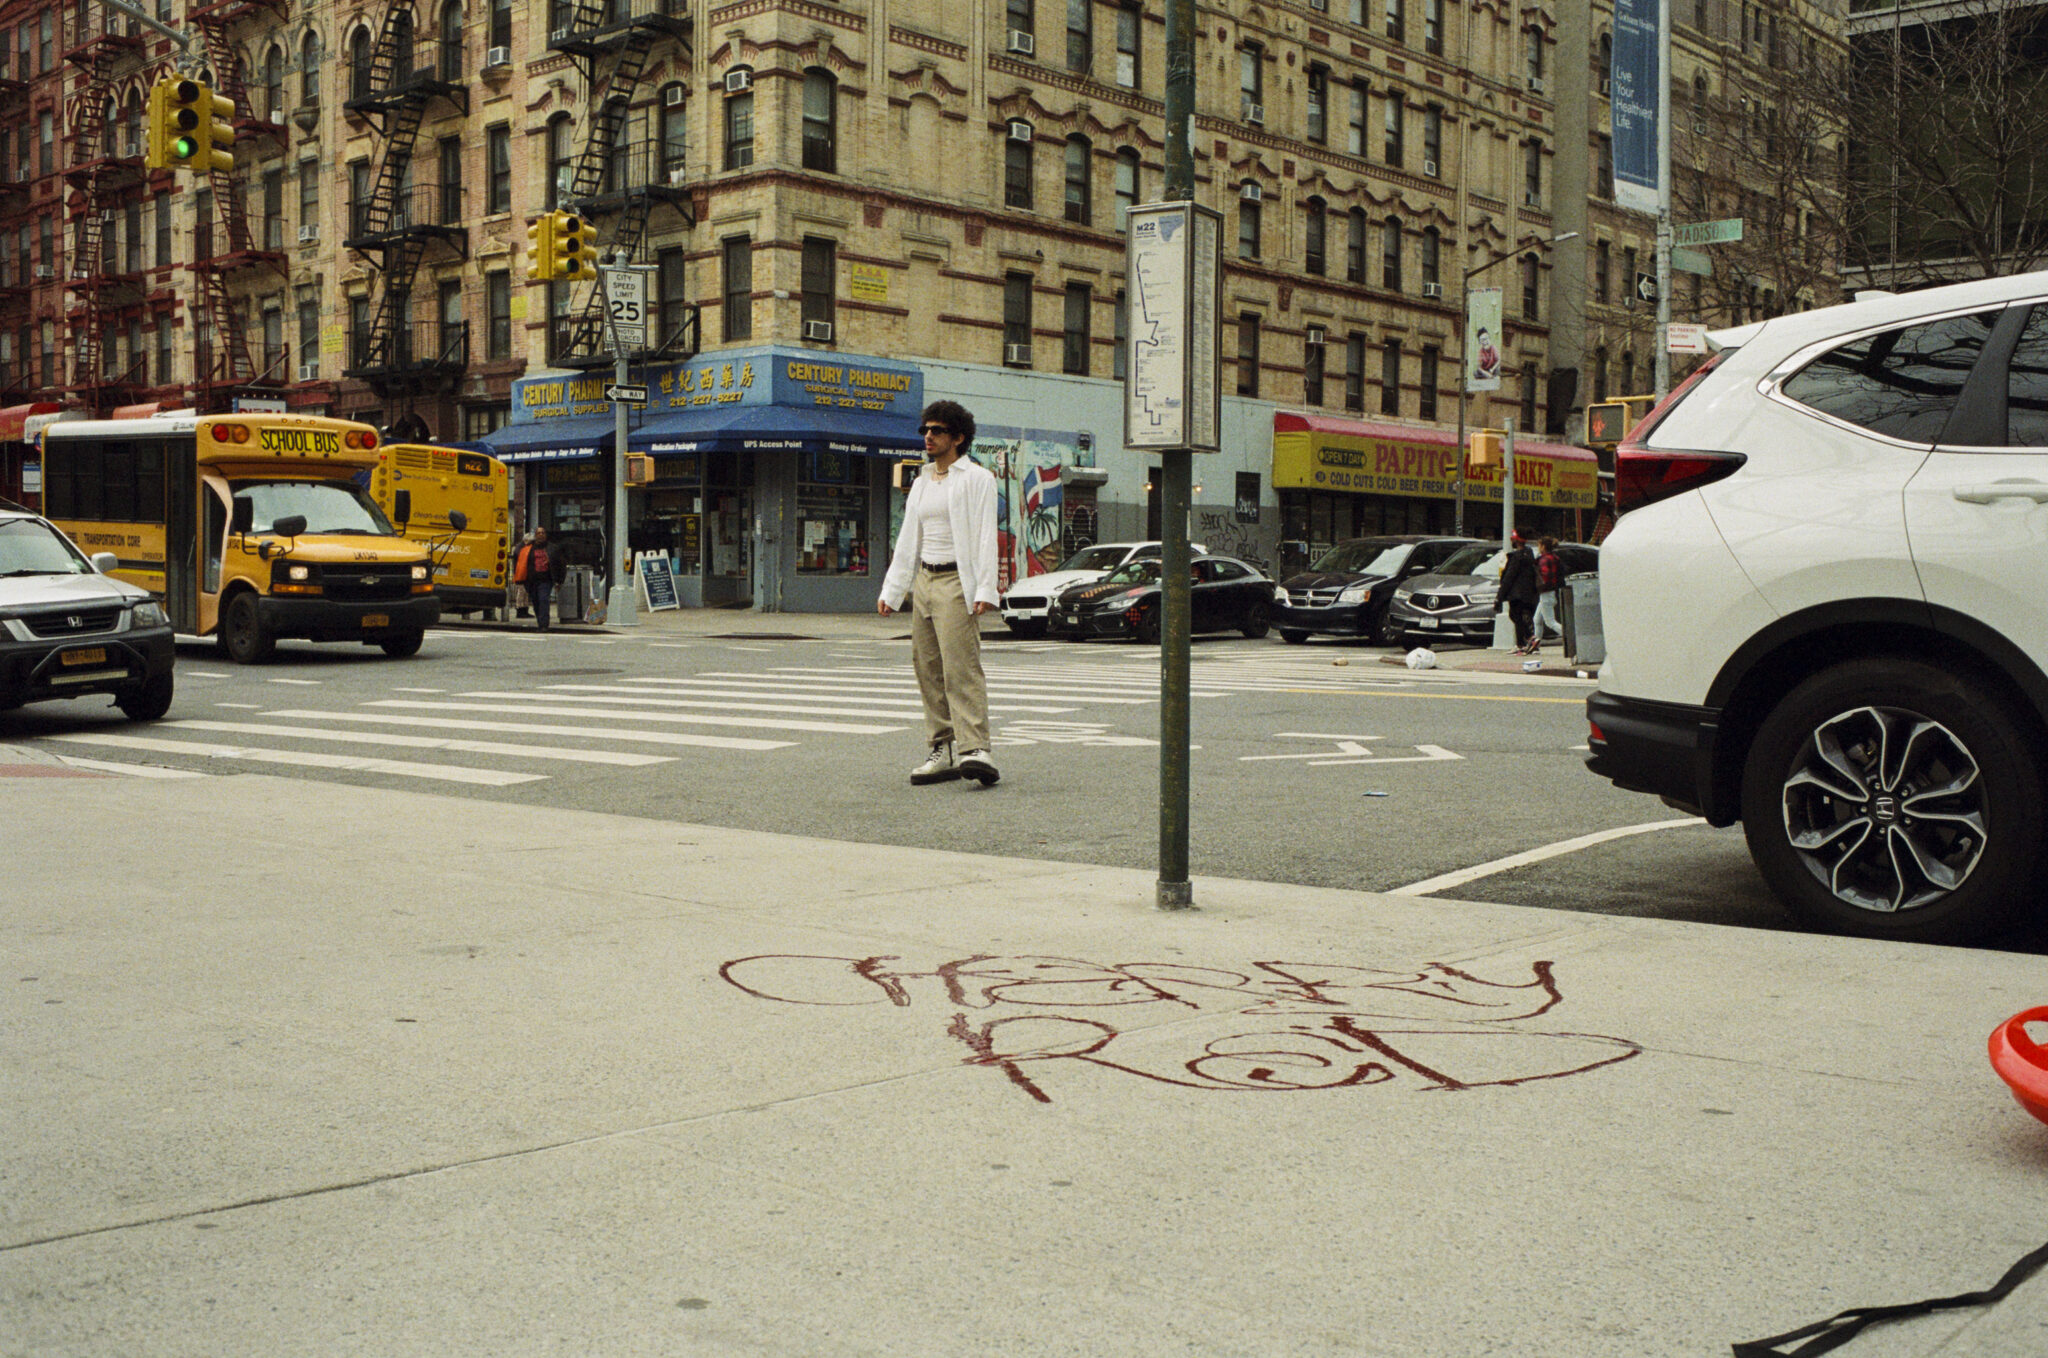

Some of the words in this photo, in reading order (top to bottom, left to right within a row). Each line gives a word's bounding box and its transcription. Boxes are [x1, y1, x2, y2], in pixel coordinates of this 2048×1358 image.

[1616, 65, 1632, 82] Live
[1616, 81, 1634, 97] Your
[1616, 97, 1653, 120] Healthiest
[1136, 222, 1155, 231] M22
[616, 273, 632, 281] CITY
[612, 282, 635, 290] SPEED
[615, 290, 633, 298] LIMIT
[611, 300, 639, 321] 25
[787, 361, 843, 386] CENTURY
[848, 371, 912, 392] PHARMACY
[523, 382, 565, 407] CENTURY
[569, 377, 617, 403] PHARM
[610, 389, 624, 397] ONE
[805, 383, 849, 397] SURGICAL
[853, 389, 895, 401] SUPPLIES
[815, 395, 885, 410] 212-227-5227
[532, 406, 570, 419] SURGICAL
[573, 402, 609, 415] SUPPLIES
[260, 429, 312, 452] SCHOOL
[314, 431, 340, 454] BUS
[743, 440, 758, 448] UPS
[759, 440, 783, 449] Access
[784, 440, 802, 449] Point
[829, 441, 849, 452] Money
[850, 444, 867, 453] Order
[1323, 450, 1341, 463] OPEN
[472, 482, 494, 493] 9439
[1330, 471, 1350, 487] COLD
[1353, 474, 1374, 489] CUTS
[1377, 476, 1397, 491] COLD
[1399, 478, 1419, 492] BEER
[1422, 479, 1445, 493] FRESH
[1468, 484, 1486, 497] SODA
[1489, 486, 1529, 501] VEGEBLES
[1531, 490, 1544, 502] ETC
[84, 533, 126, 547] TRANSPORTATION
